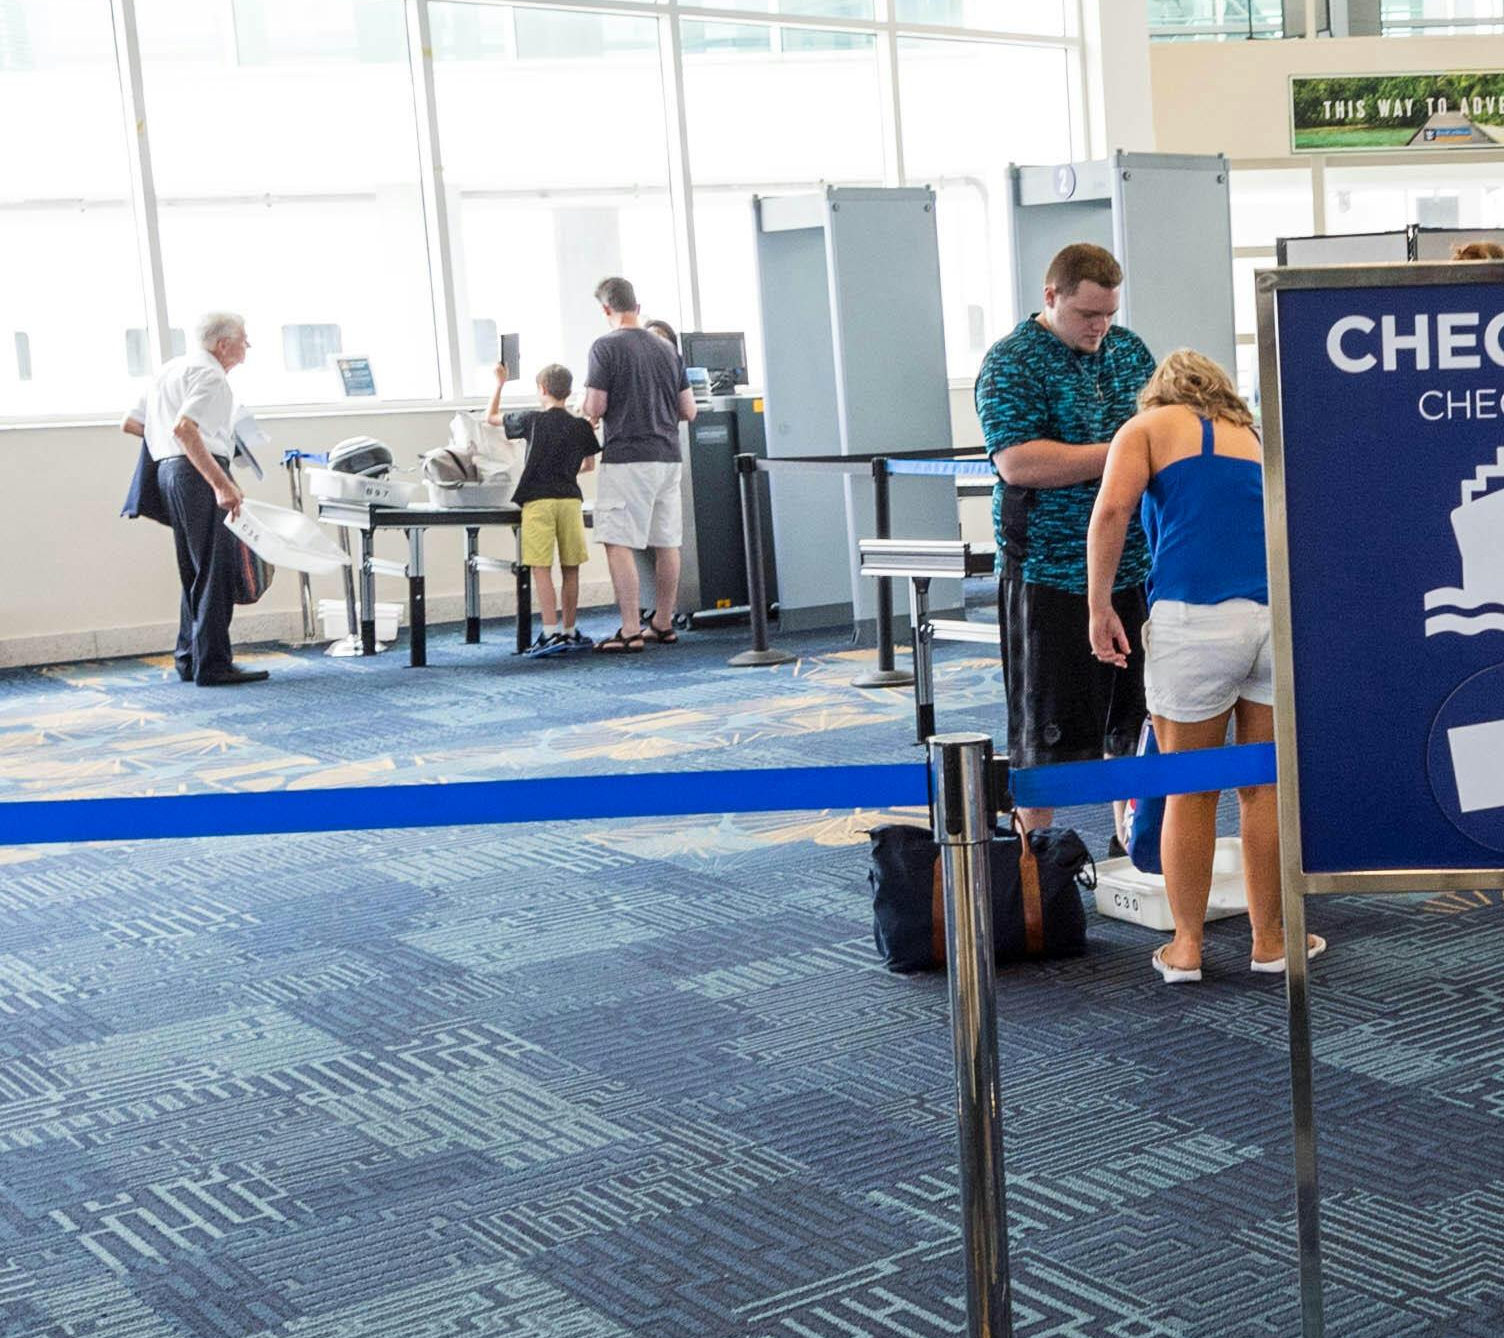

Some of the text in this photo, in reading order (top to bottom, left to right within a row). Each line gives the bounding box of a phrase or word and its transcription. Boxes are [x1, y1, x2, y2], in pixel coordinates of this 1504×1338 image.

[1323, 99, 1366, 119] THIS
[1377, 98, 1414, 118] WAY
[1427, 97, 1447, 116] TO
[1058, 168, 1069, 194] 2
[1114, 893, 1139, 912] C30
